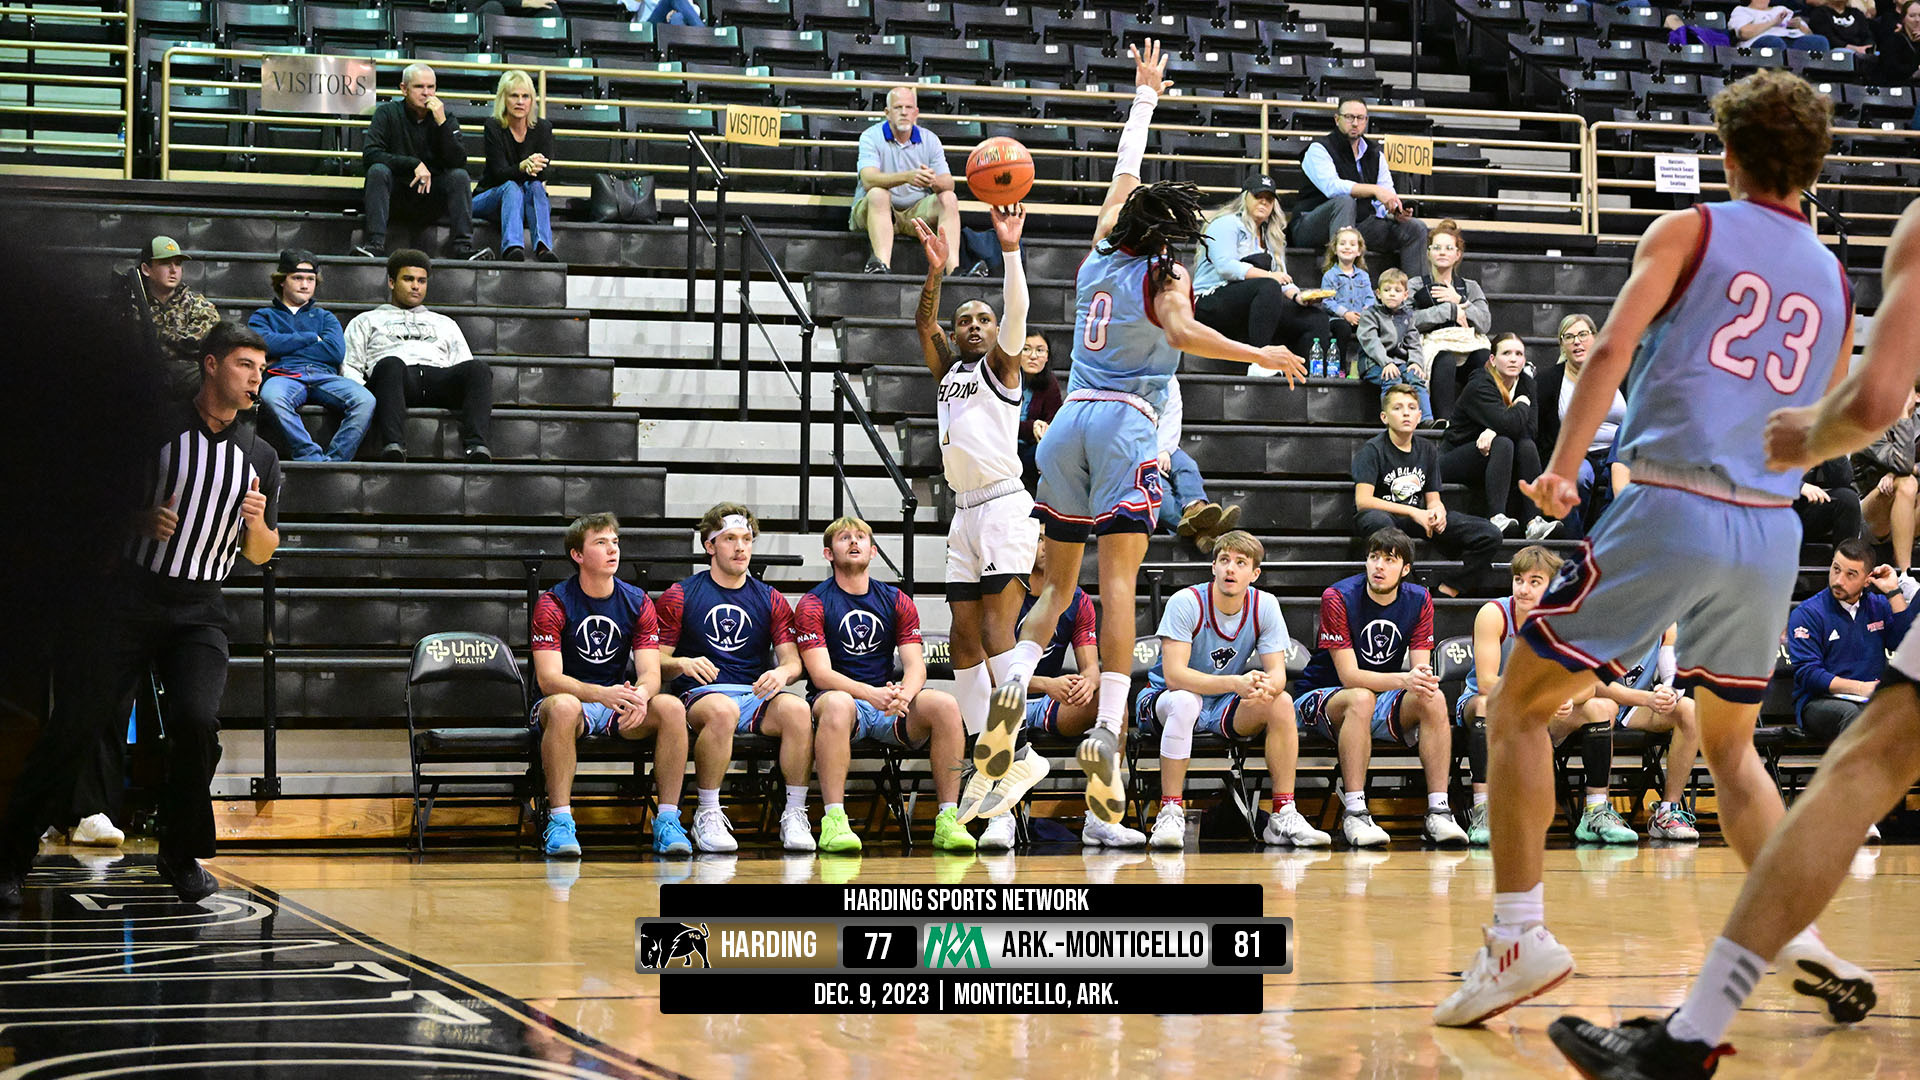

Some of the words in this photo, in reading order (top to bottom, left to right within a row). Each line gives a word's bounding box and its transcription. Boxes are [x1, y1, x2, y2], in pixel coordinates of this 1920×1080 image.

[271, 71, 367, 97] VISITORS
[729, 112, 778, 138] VISITOR
[1386, 142, 1430, 167] VISITOR
[1083, 291, 1114, 352] 0
[1707, 271, 1823, 396] 23
[451, 640, 499, 660] Unity
